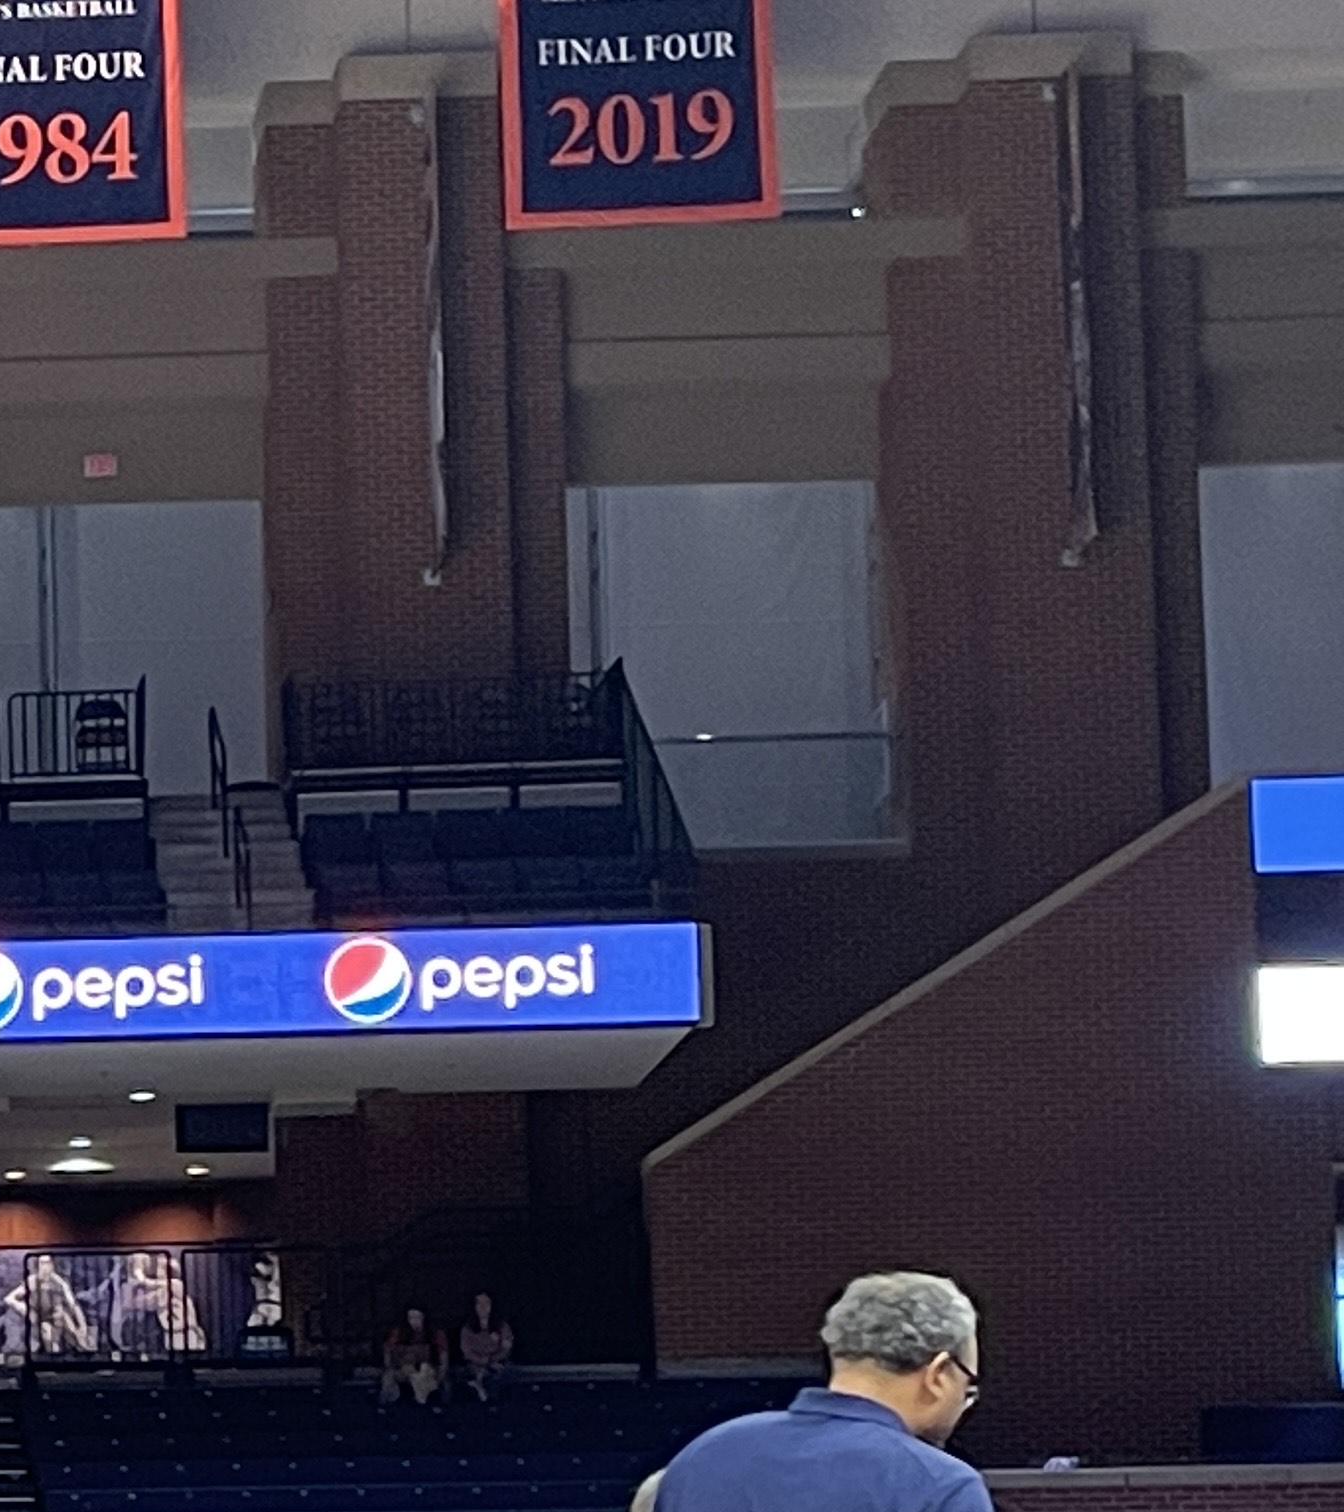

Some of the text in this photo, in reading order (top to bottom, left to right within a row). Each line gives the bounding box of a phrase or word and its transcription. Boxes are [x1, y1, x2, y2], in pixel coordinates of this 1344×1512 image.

[53, 51, 146, 82] FOUR
[538, 30, 736, 67] FINAL FOUR
[547, 88, 735, 167] 2019
[32, 953, 206, 1022] pepsi
[421, 943, 595, 1011] pepsi
